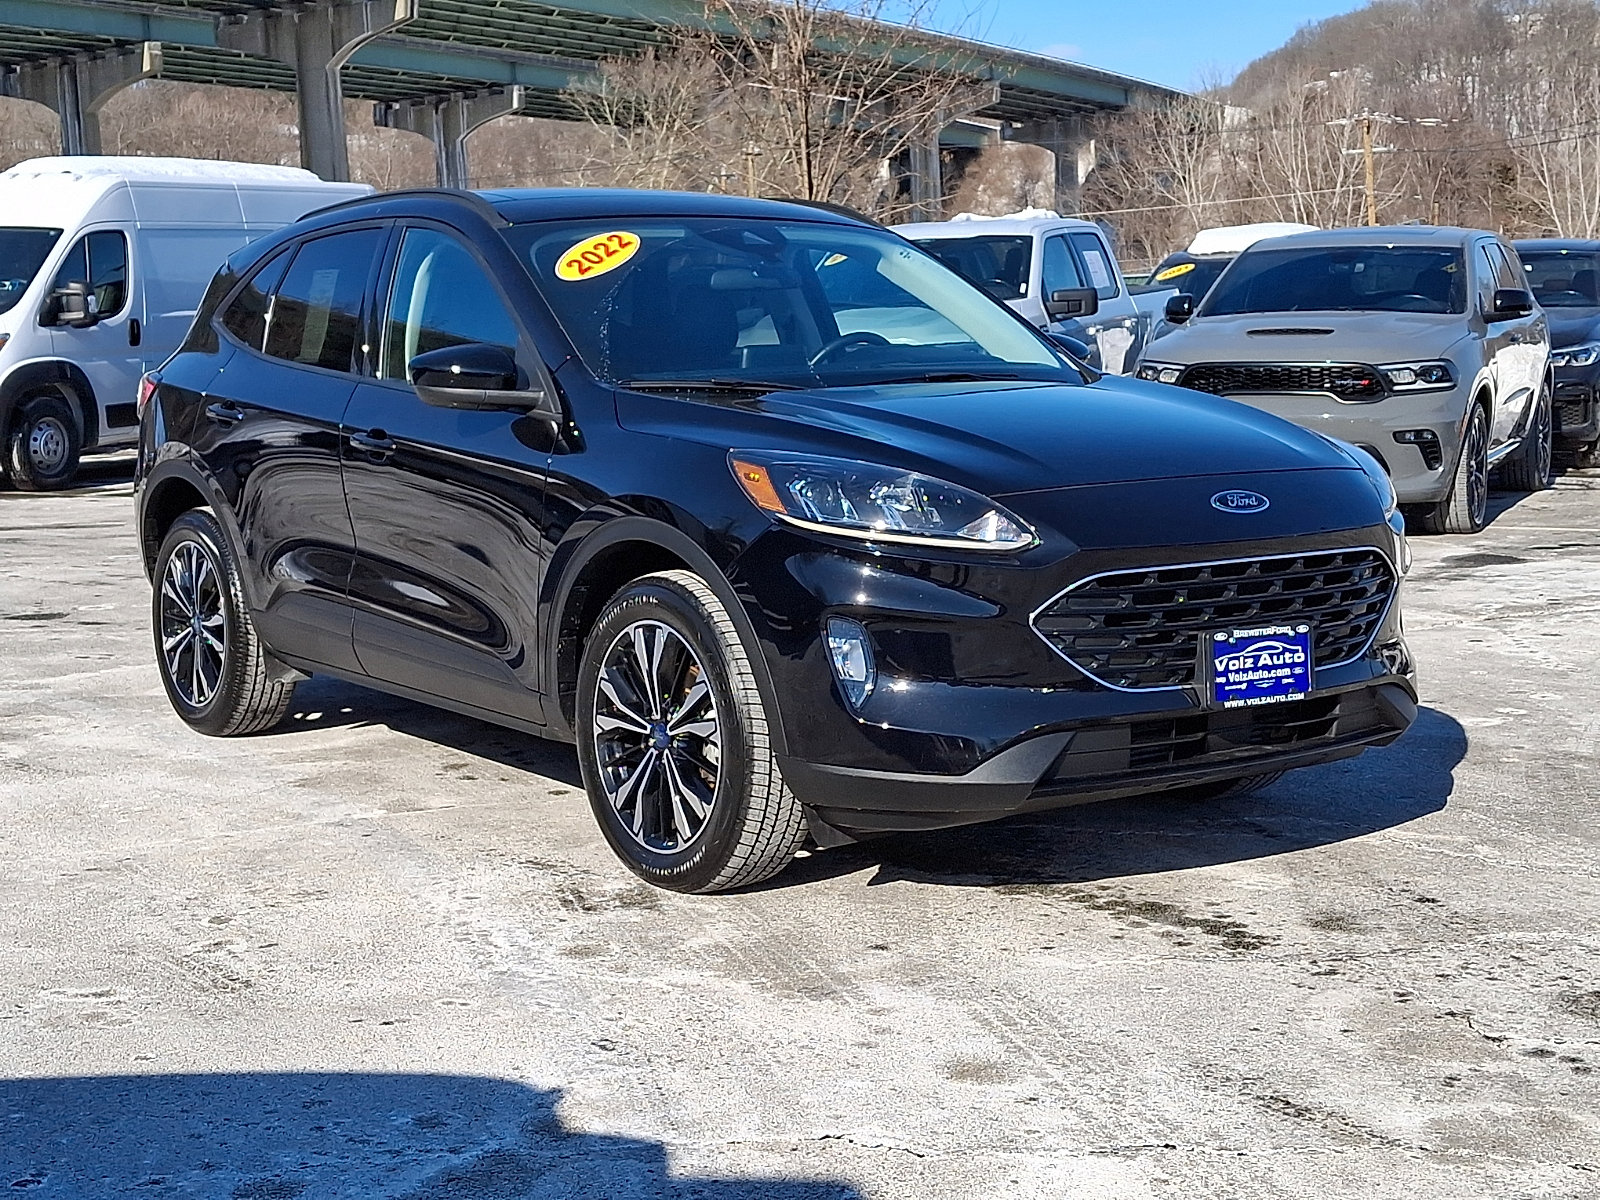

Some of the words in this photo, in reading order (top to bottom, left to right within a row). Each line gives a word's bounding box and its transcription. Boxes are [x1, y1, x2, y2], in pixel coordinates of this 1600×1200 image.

[566, 234, 633, 275] 2022
[1226, 493, 1259, 507] Ford
[1214, 656, 1254, 672] Volz
[1257, 652, 1305, 667] Auto
[1228, 668, 1291, 683] VolzAuto.com
